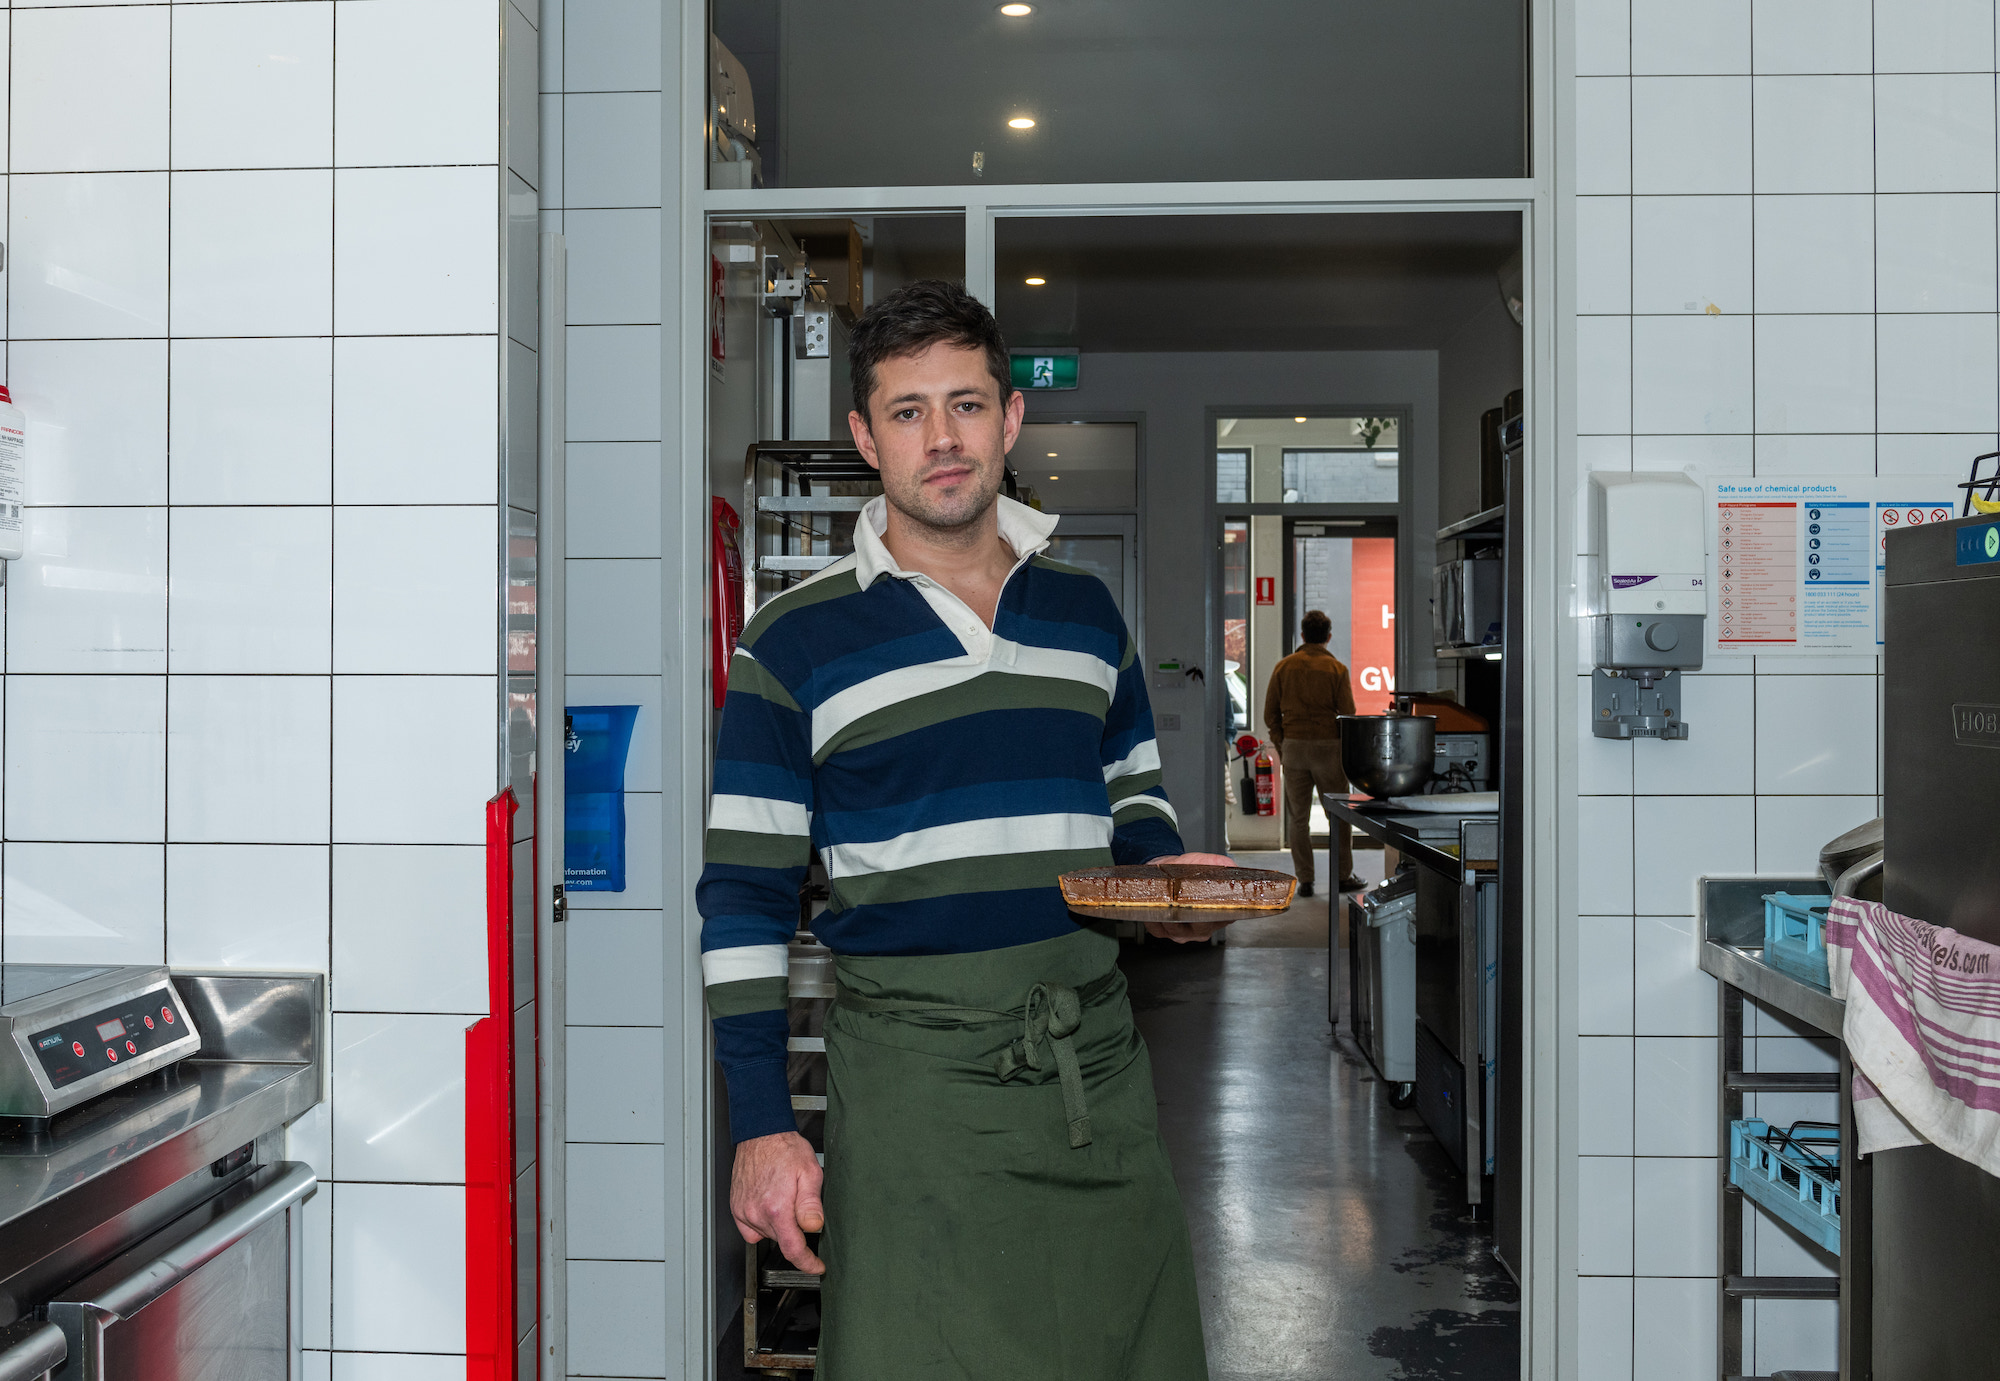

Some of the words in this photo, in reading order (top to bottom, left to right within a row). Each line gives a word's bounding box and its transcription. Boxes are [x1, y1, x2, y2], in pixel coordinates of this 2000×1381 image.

[1718, 485, 1736, 493] Safe
[1754, 485, 1763, 493] of
[1765, 485, 1800, 493] chemical
[1802, 485, 1837, 495] products
